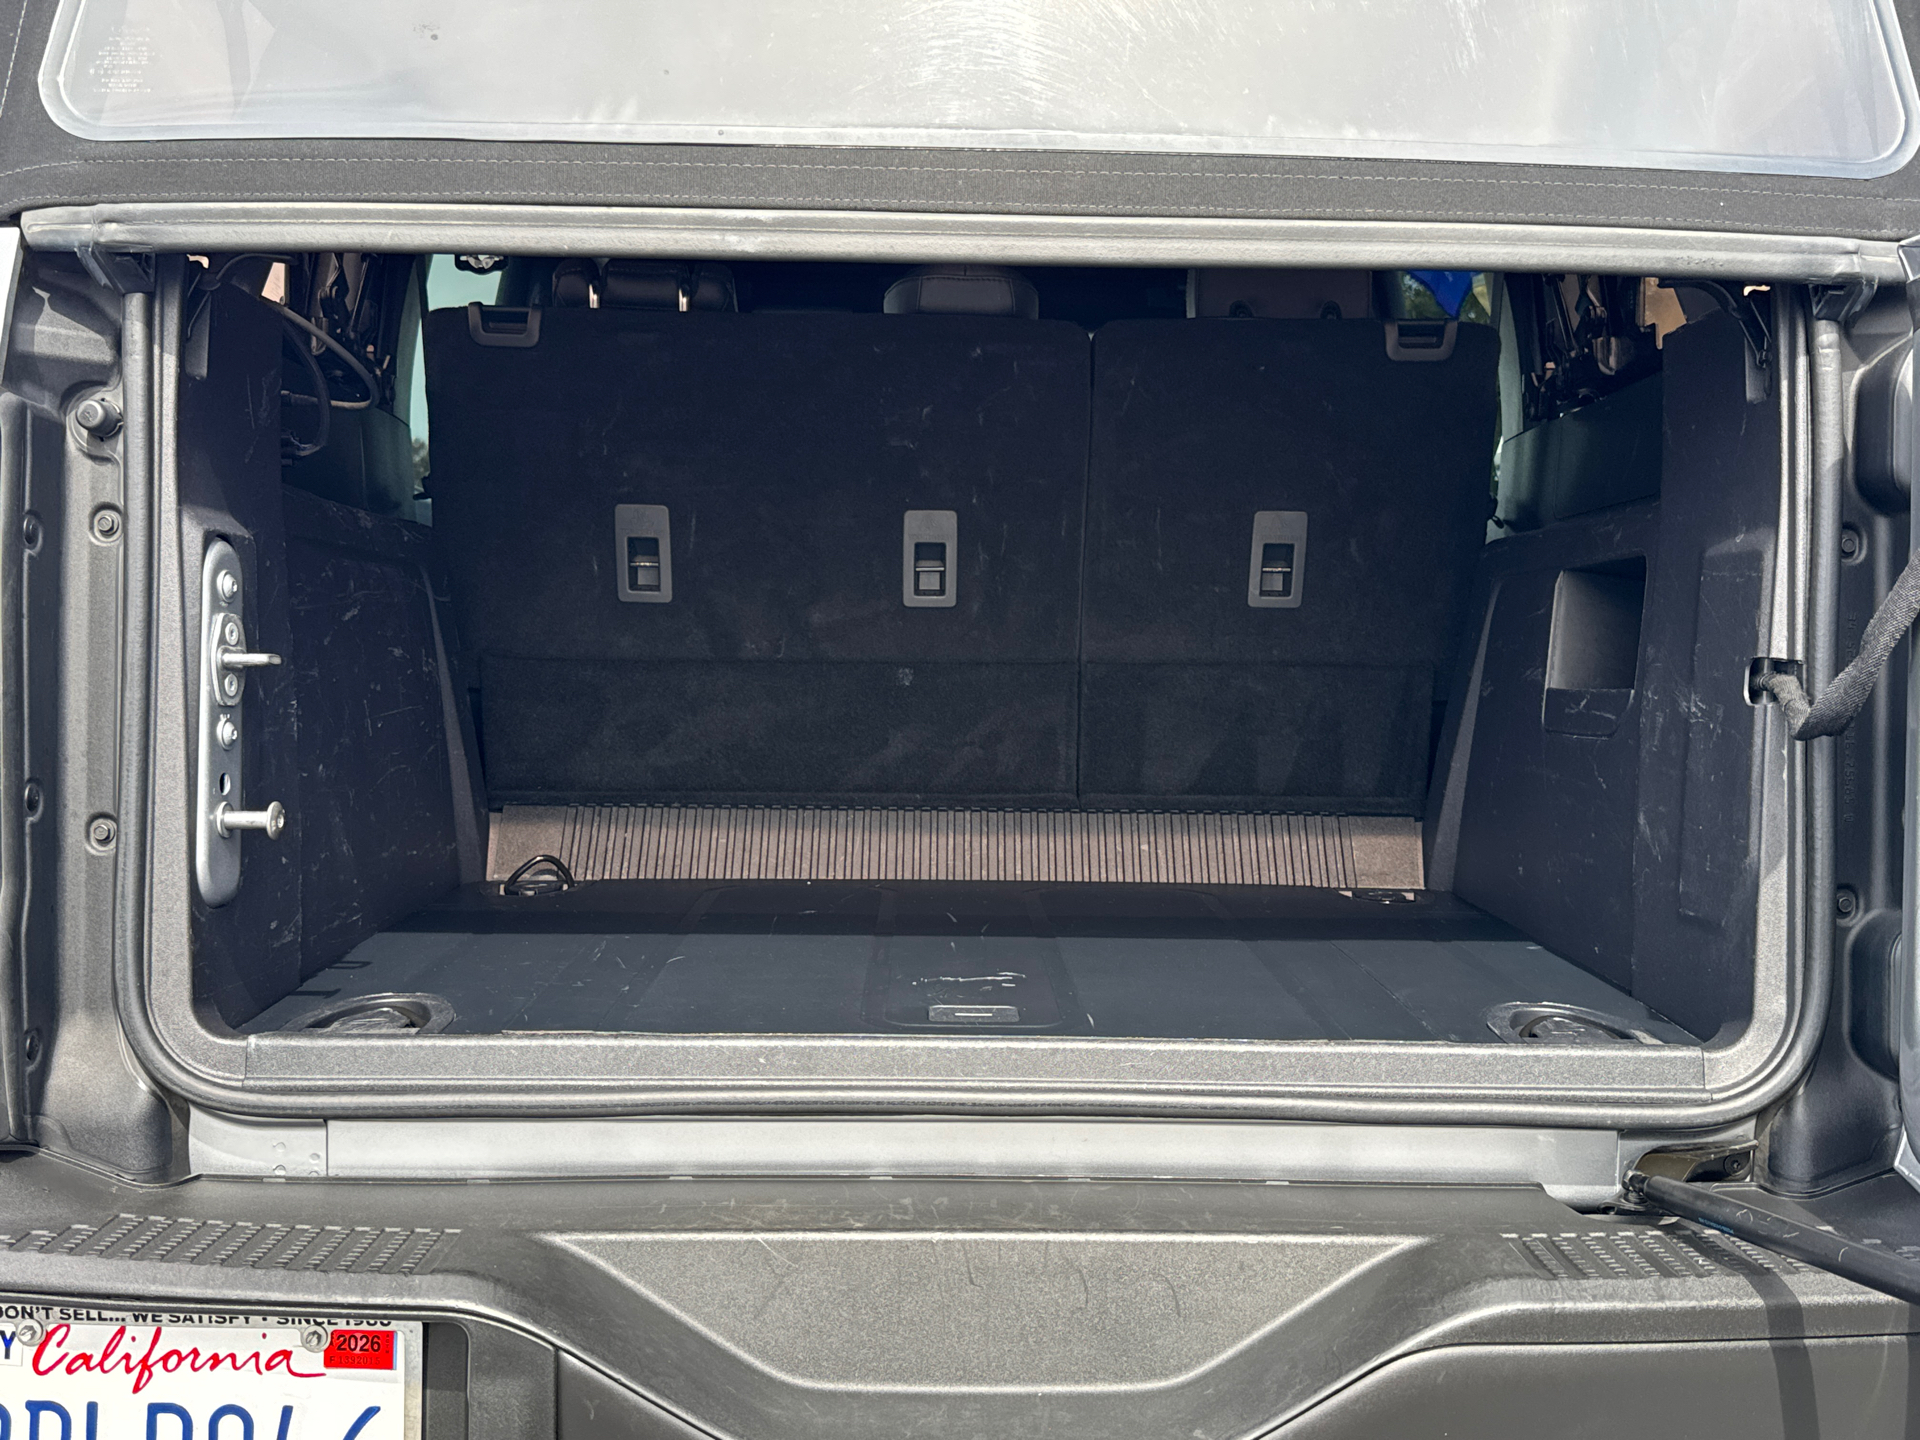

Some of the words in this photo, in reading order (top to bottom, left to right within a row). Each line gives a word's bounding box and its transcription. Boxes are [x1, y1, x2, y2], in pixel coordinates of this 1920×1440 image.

[132, 1313, 163, 1323] WE
[336, 1333, 381, 1353] 2026
[32, 1323, 327, 1394] California
